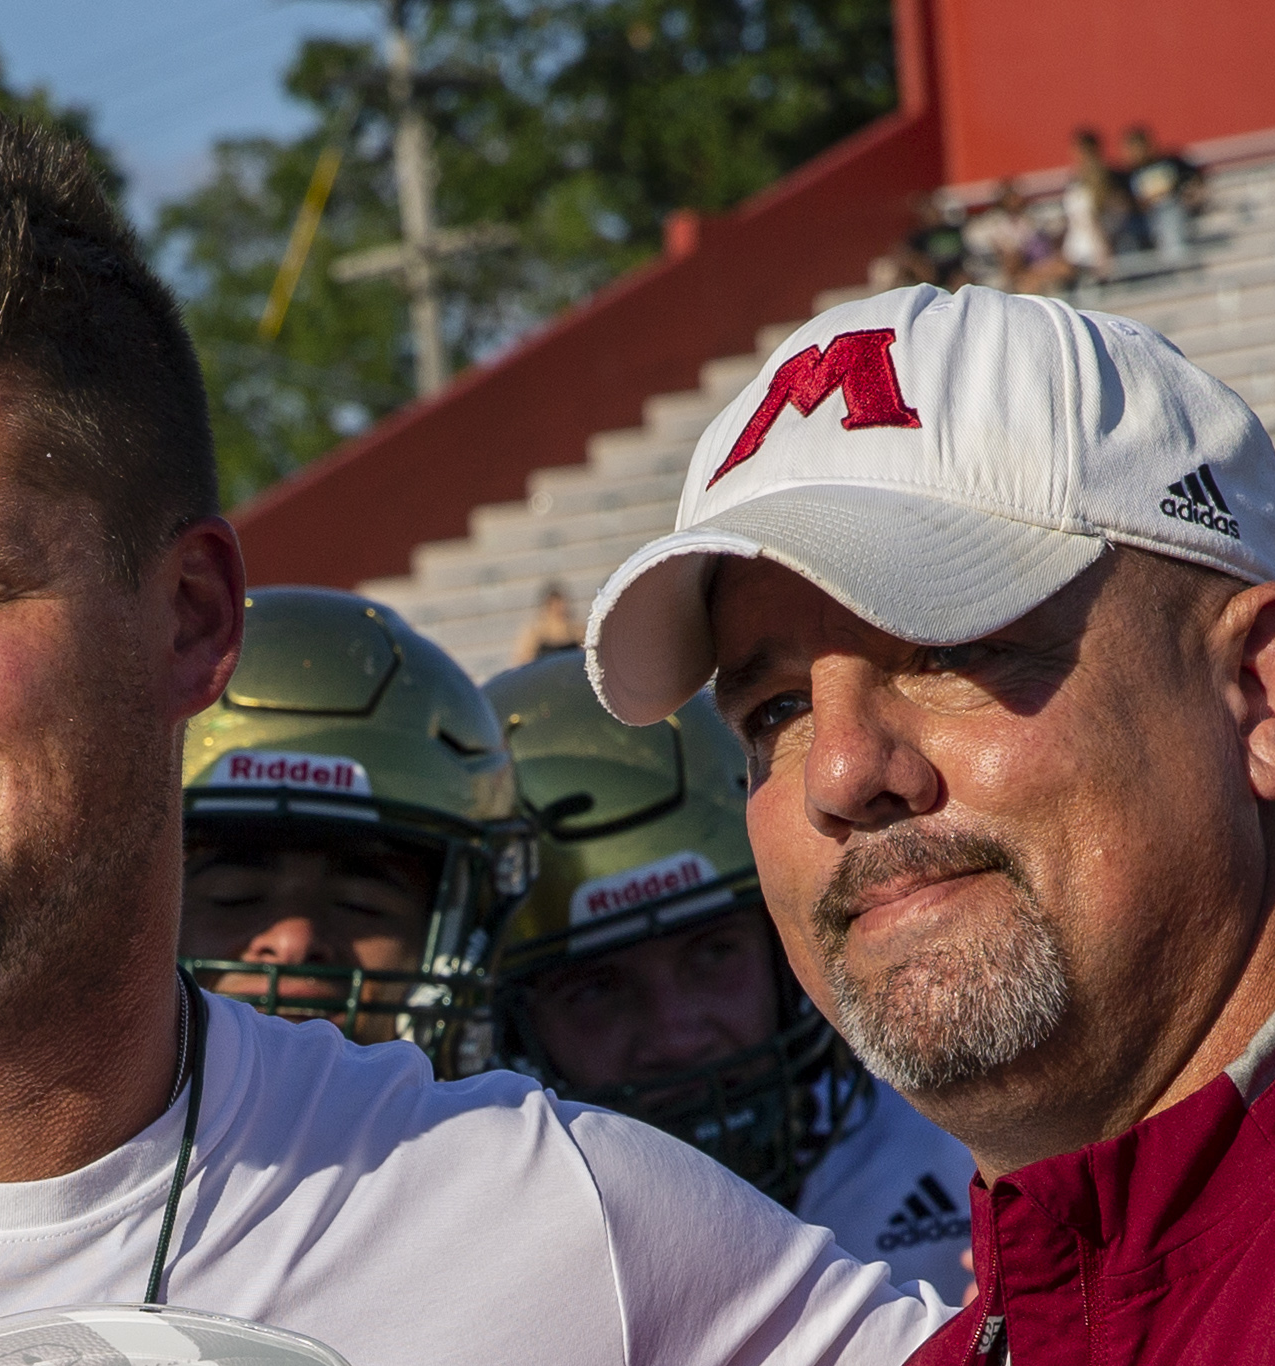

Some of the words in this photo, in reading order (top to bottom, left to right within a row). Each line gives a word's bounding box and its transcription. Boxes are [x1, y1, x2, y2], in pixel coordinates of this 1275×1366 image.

[706, 327, 922, 491] M
[1160, 492, 1241, 540] adidas
[229, 754, 356, 790] Riddell
[587, 862, 701, 917] Riddell
